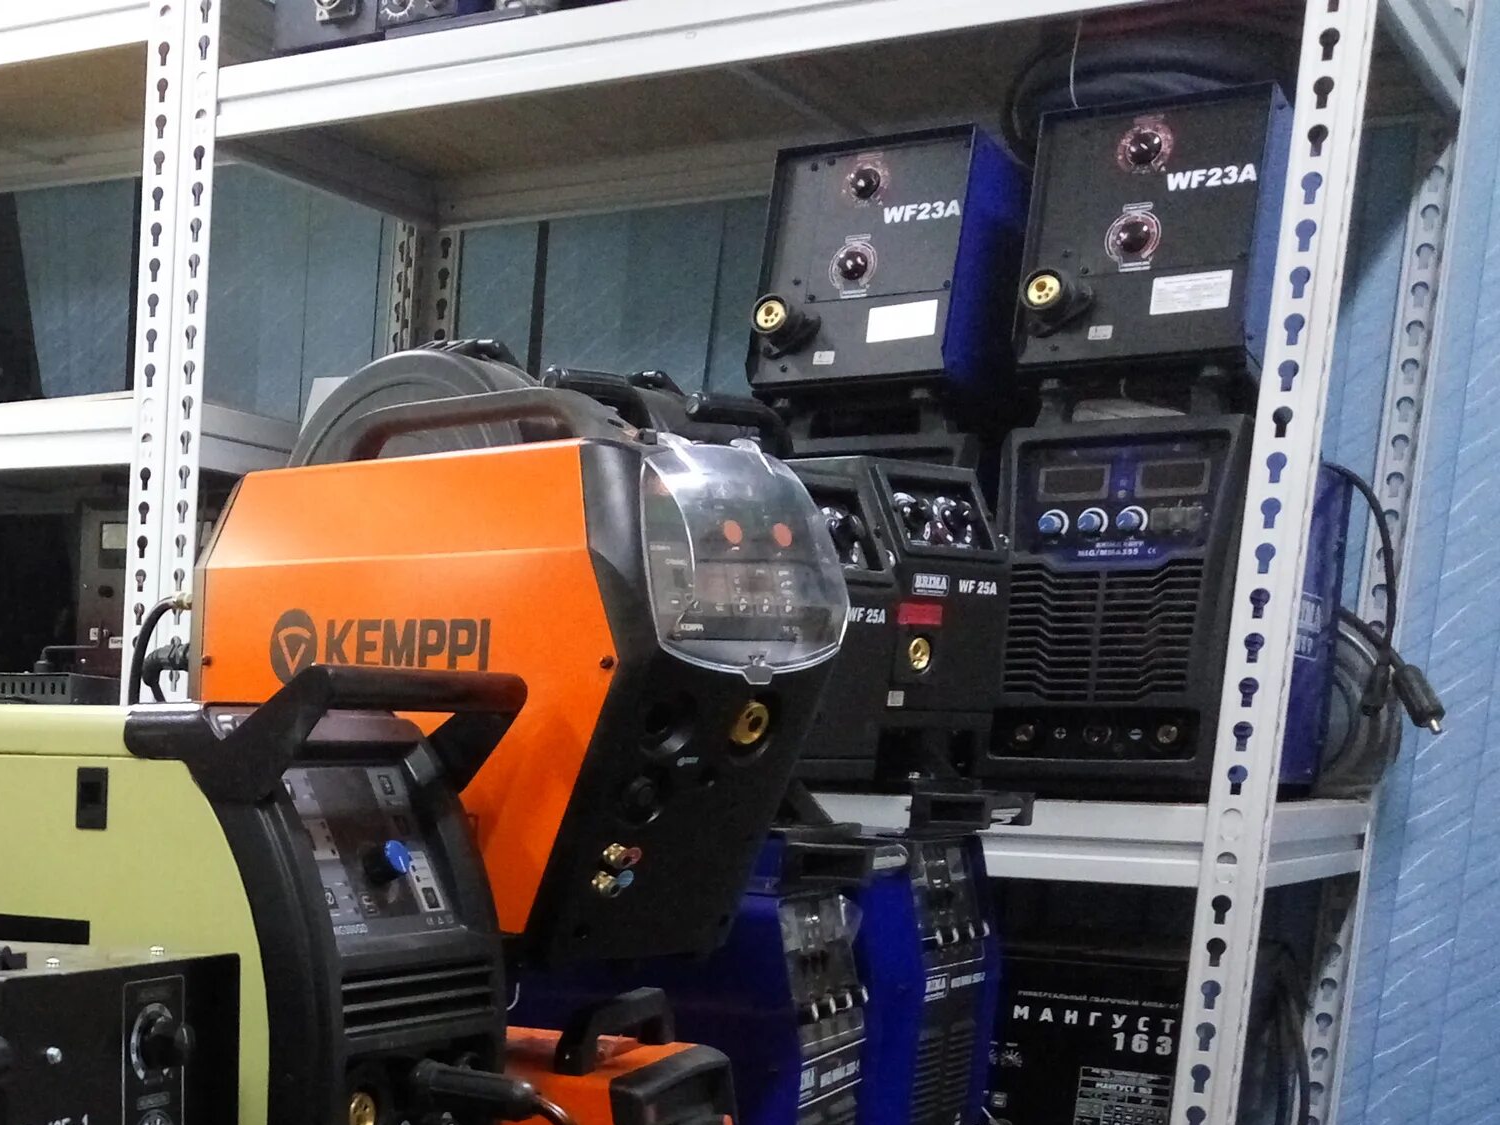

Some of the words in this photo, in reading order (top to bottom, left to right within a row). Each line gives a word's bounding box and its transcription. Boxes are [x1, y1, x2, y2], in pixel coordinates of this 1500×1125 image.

[1167, 163, 1257, 191] WF23A
[883, 200, 960, 224] WF23A
[914, 574, 947, 590] BRIMA
[959, 579, 975, 595] WF
[977, 580, 998, 596] 25A
[865, 608, 886, 624] 25A
[325, 618, 491, 671] KEMPPI
[1012, 1004, 1176, 1034] МАНГУСТ
[1112, 1032, 1173, 1056] 163
